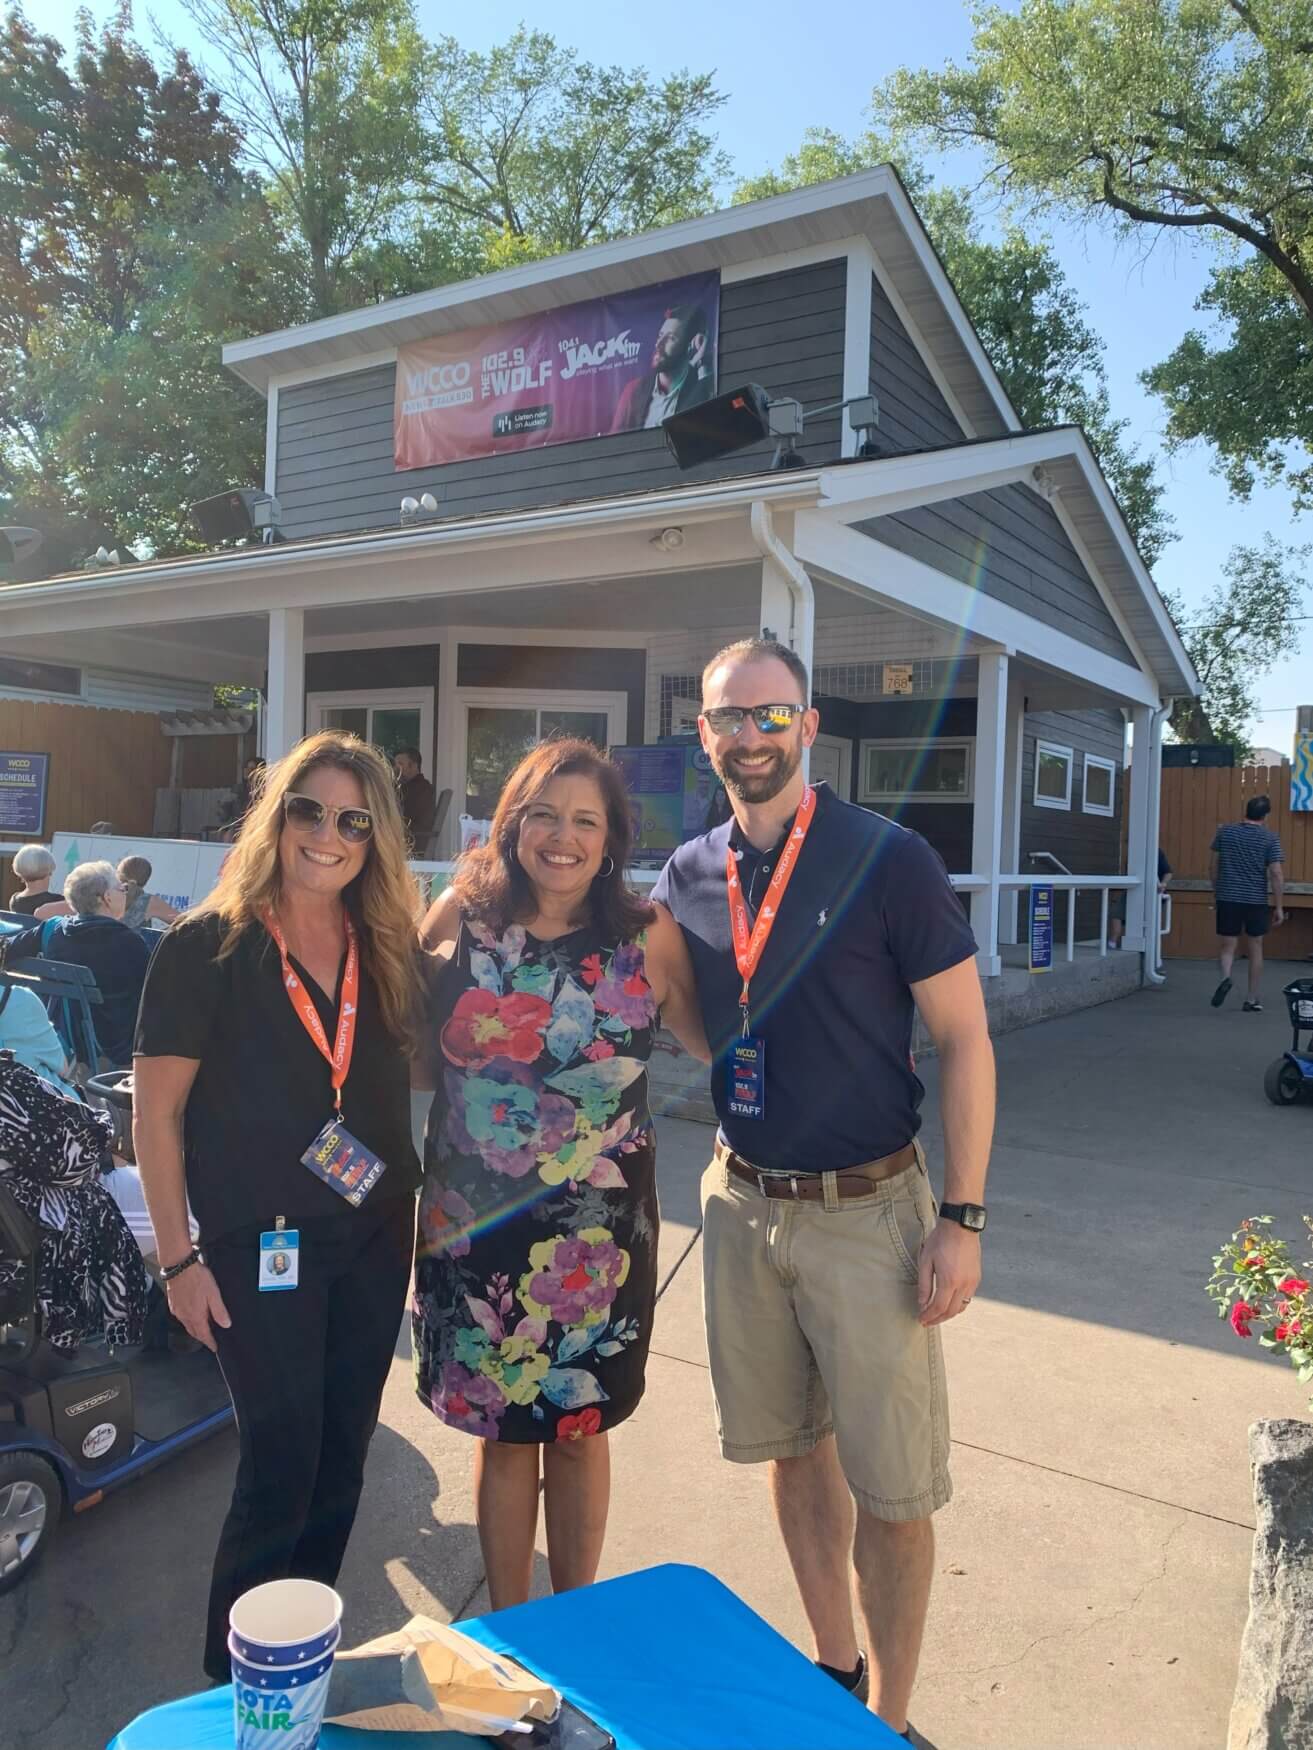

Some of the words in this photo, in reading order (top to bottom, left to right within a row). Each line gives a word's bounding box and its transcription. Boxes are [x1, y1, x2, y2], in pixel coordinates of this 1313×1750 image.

[482, 347, 525, 371] 102.9
[406, 362, 471, 396] WCCO
[491, 360, 553, 397] WOLF
[771, 842, 796, 888] Audacy
[335, 1020, 351, 1071] Audacy
[730, 1102, 761, 1116] STAFF
[352, 1162, 381, 1202] STAFF
[238, 1703, 292, 1731] FAIR
